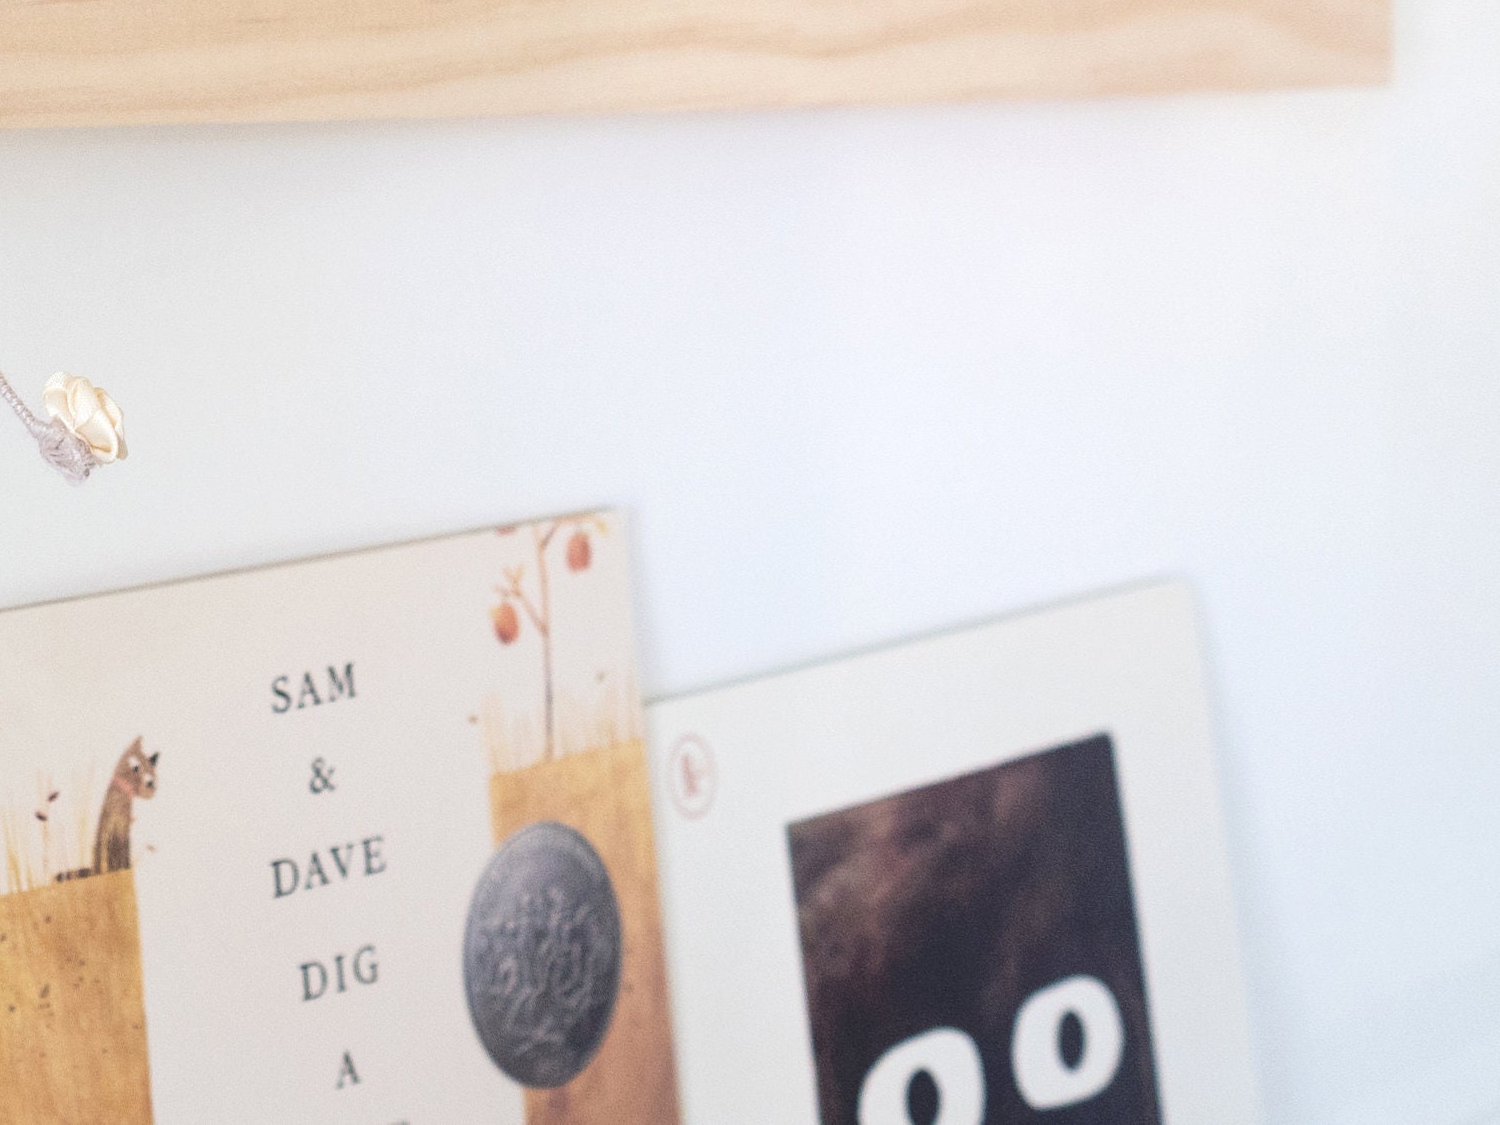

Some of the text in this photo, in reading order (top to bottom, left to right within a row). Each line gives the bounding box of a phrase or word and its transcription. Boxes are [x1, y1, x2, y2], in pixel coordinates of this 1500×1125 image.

[270, 662, 357, 714] SAM
[308, 757, 336, 795] &
[269, 836, 388, 899] DAVE
[298, 944, 379, 1002] DIG
[335, 1051, 363, 1090] A
